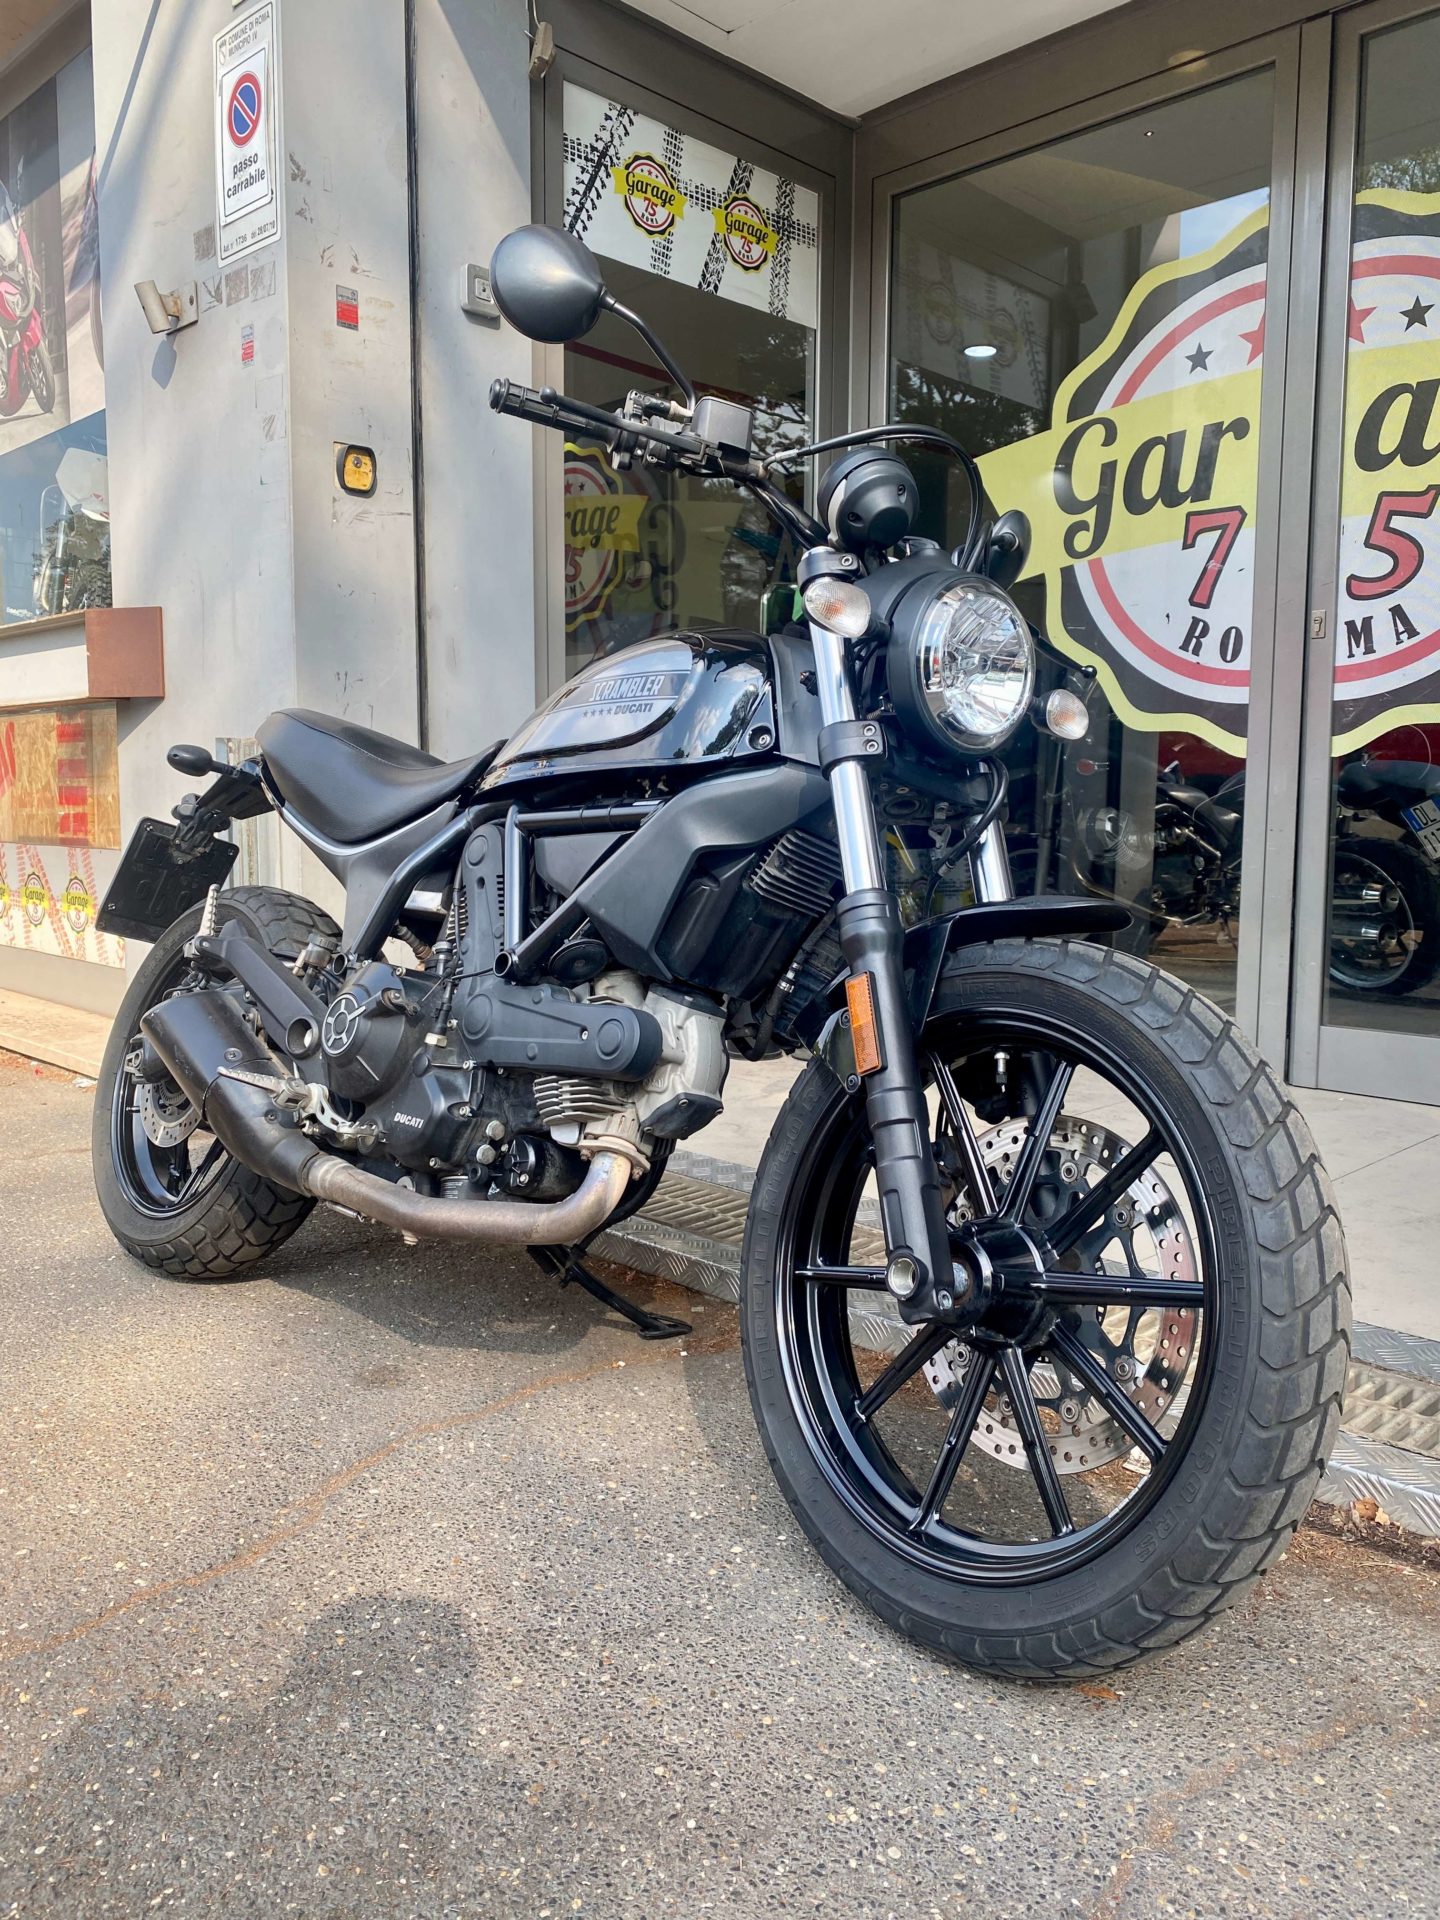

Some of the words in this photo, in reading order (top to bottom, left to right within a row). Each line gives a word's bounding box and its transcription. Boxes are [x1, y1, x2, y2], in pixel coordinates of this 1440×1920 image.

[255, 10, 270, 27] ROMA
[233, 153, 259, 179] passo
[226, 168, 266, 199] carrabile
[625, 171, 676, 209] Garage
[643, 196, 659, 217] 75
[724, 210, 769, 245] Garage
[740, 235, 754, 254] 75
[589, 675, 666, 702] SCRAMBLER
[613, 702, 654, 716] DUCATI
[393, 1111, 424, 1129] DUCATI
